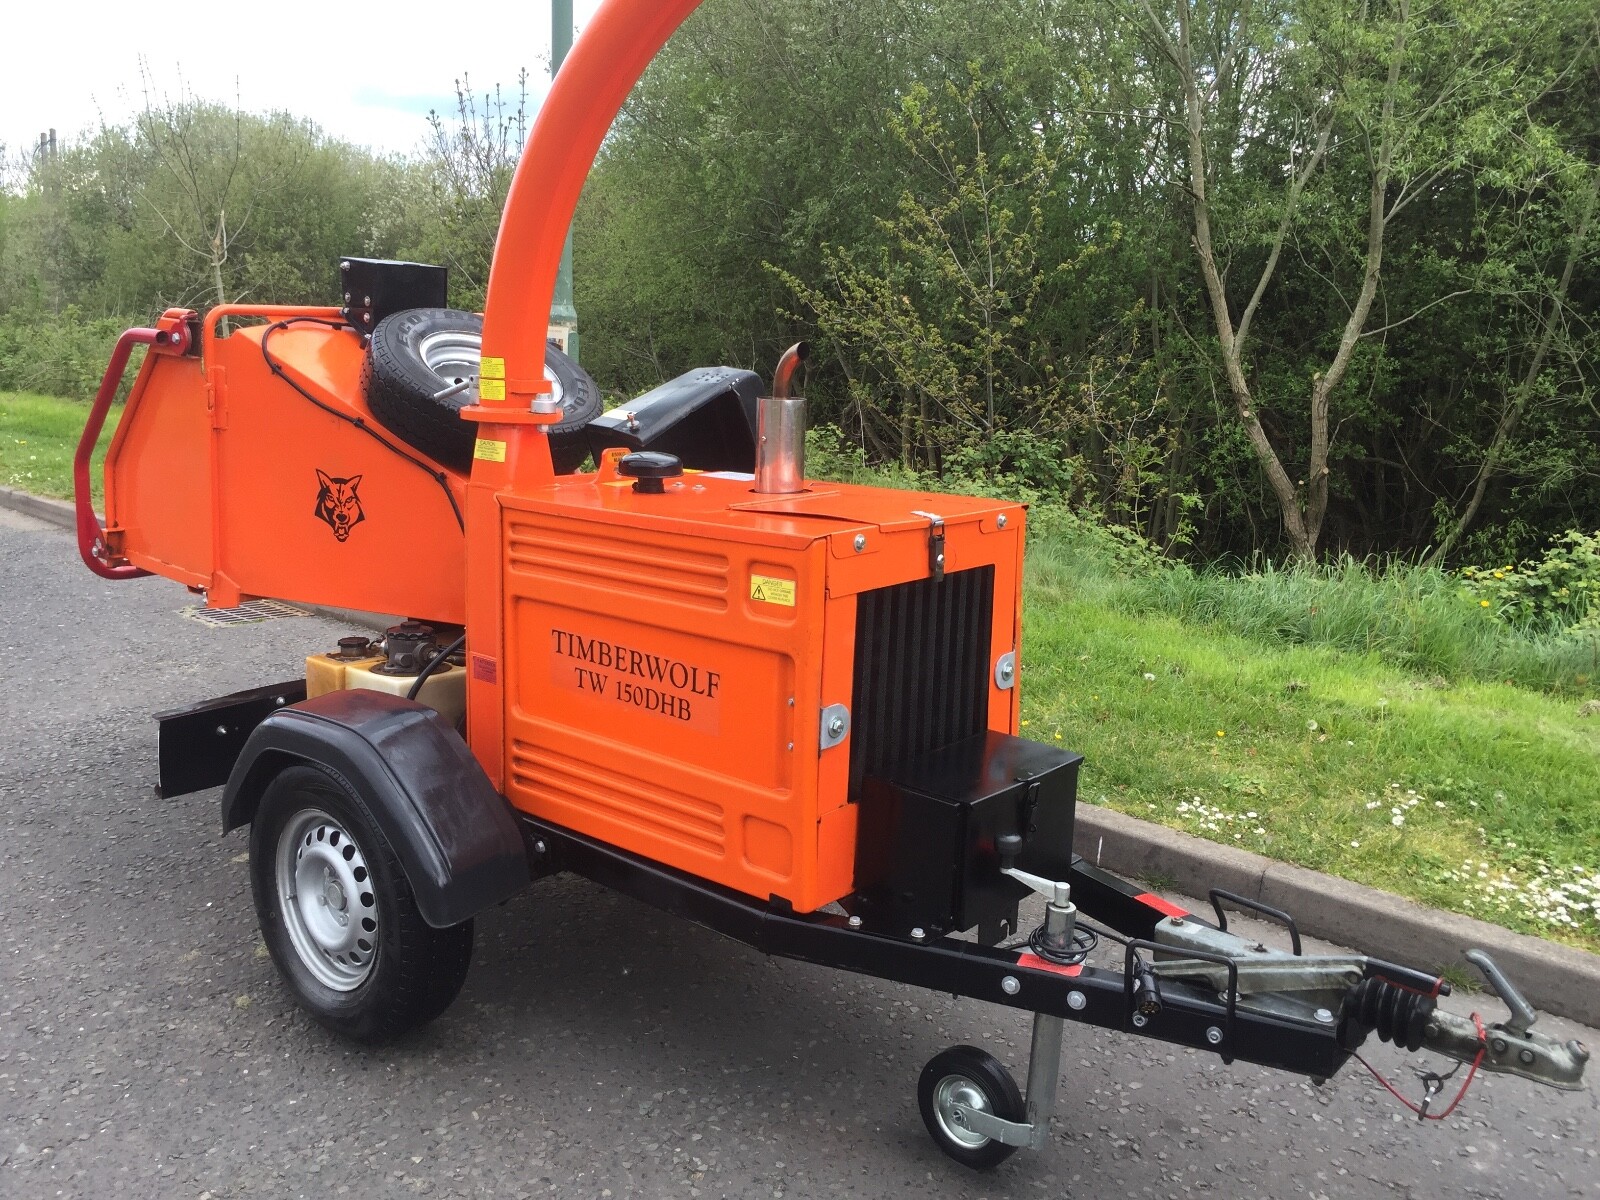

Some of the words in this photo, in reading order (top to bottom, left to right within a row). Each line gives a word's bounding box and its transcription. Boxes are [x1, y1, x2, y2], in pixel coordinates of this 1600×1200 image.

[551, 628, 721, 699] TIMBERWOLF
[574, 667, 608, 695] TW
[616, 681, 692, 721] 150DHB
